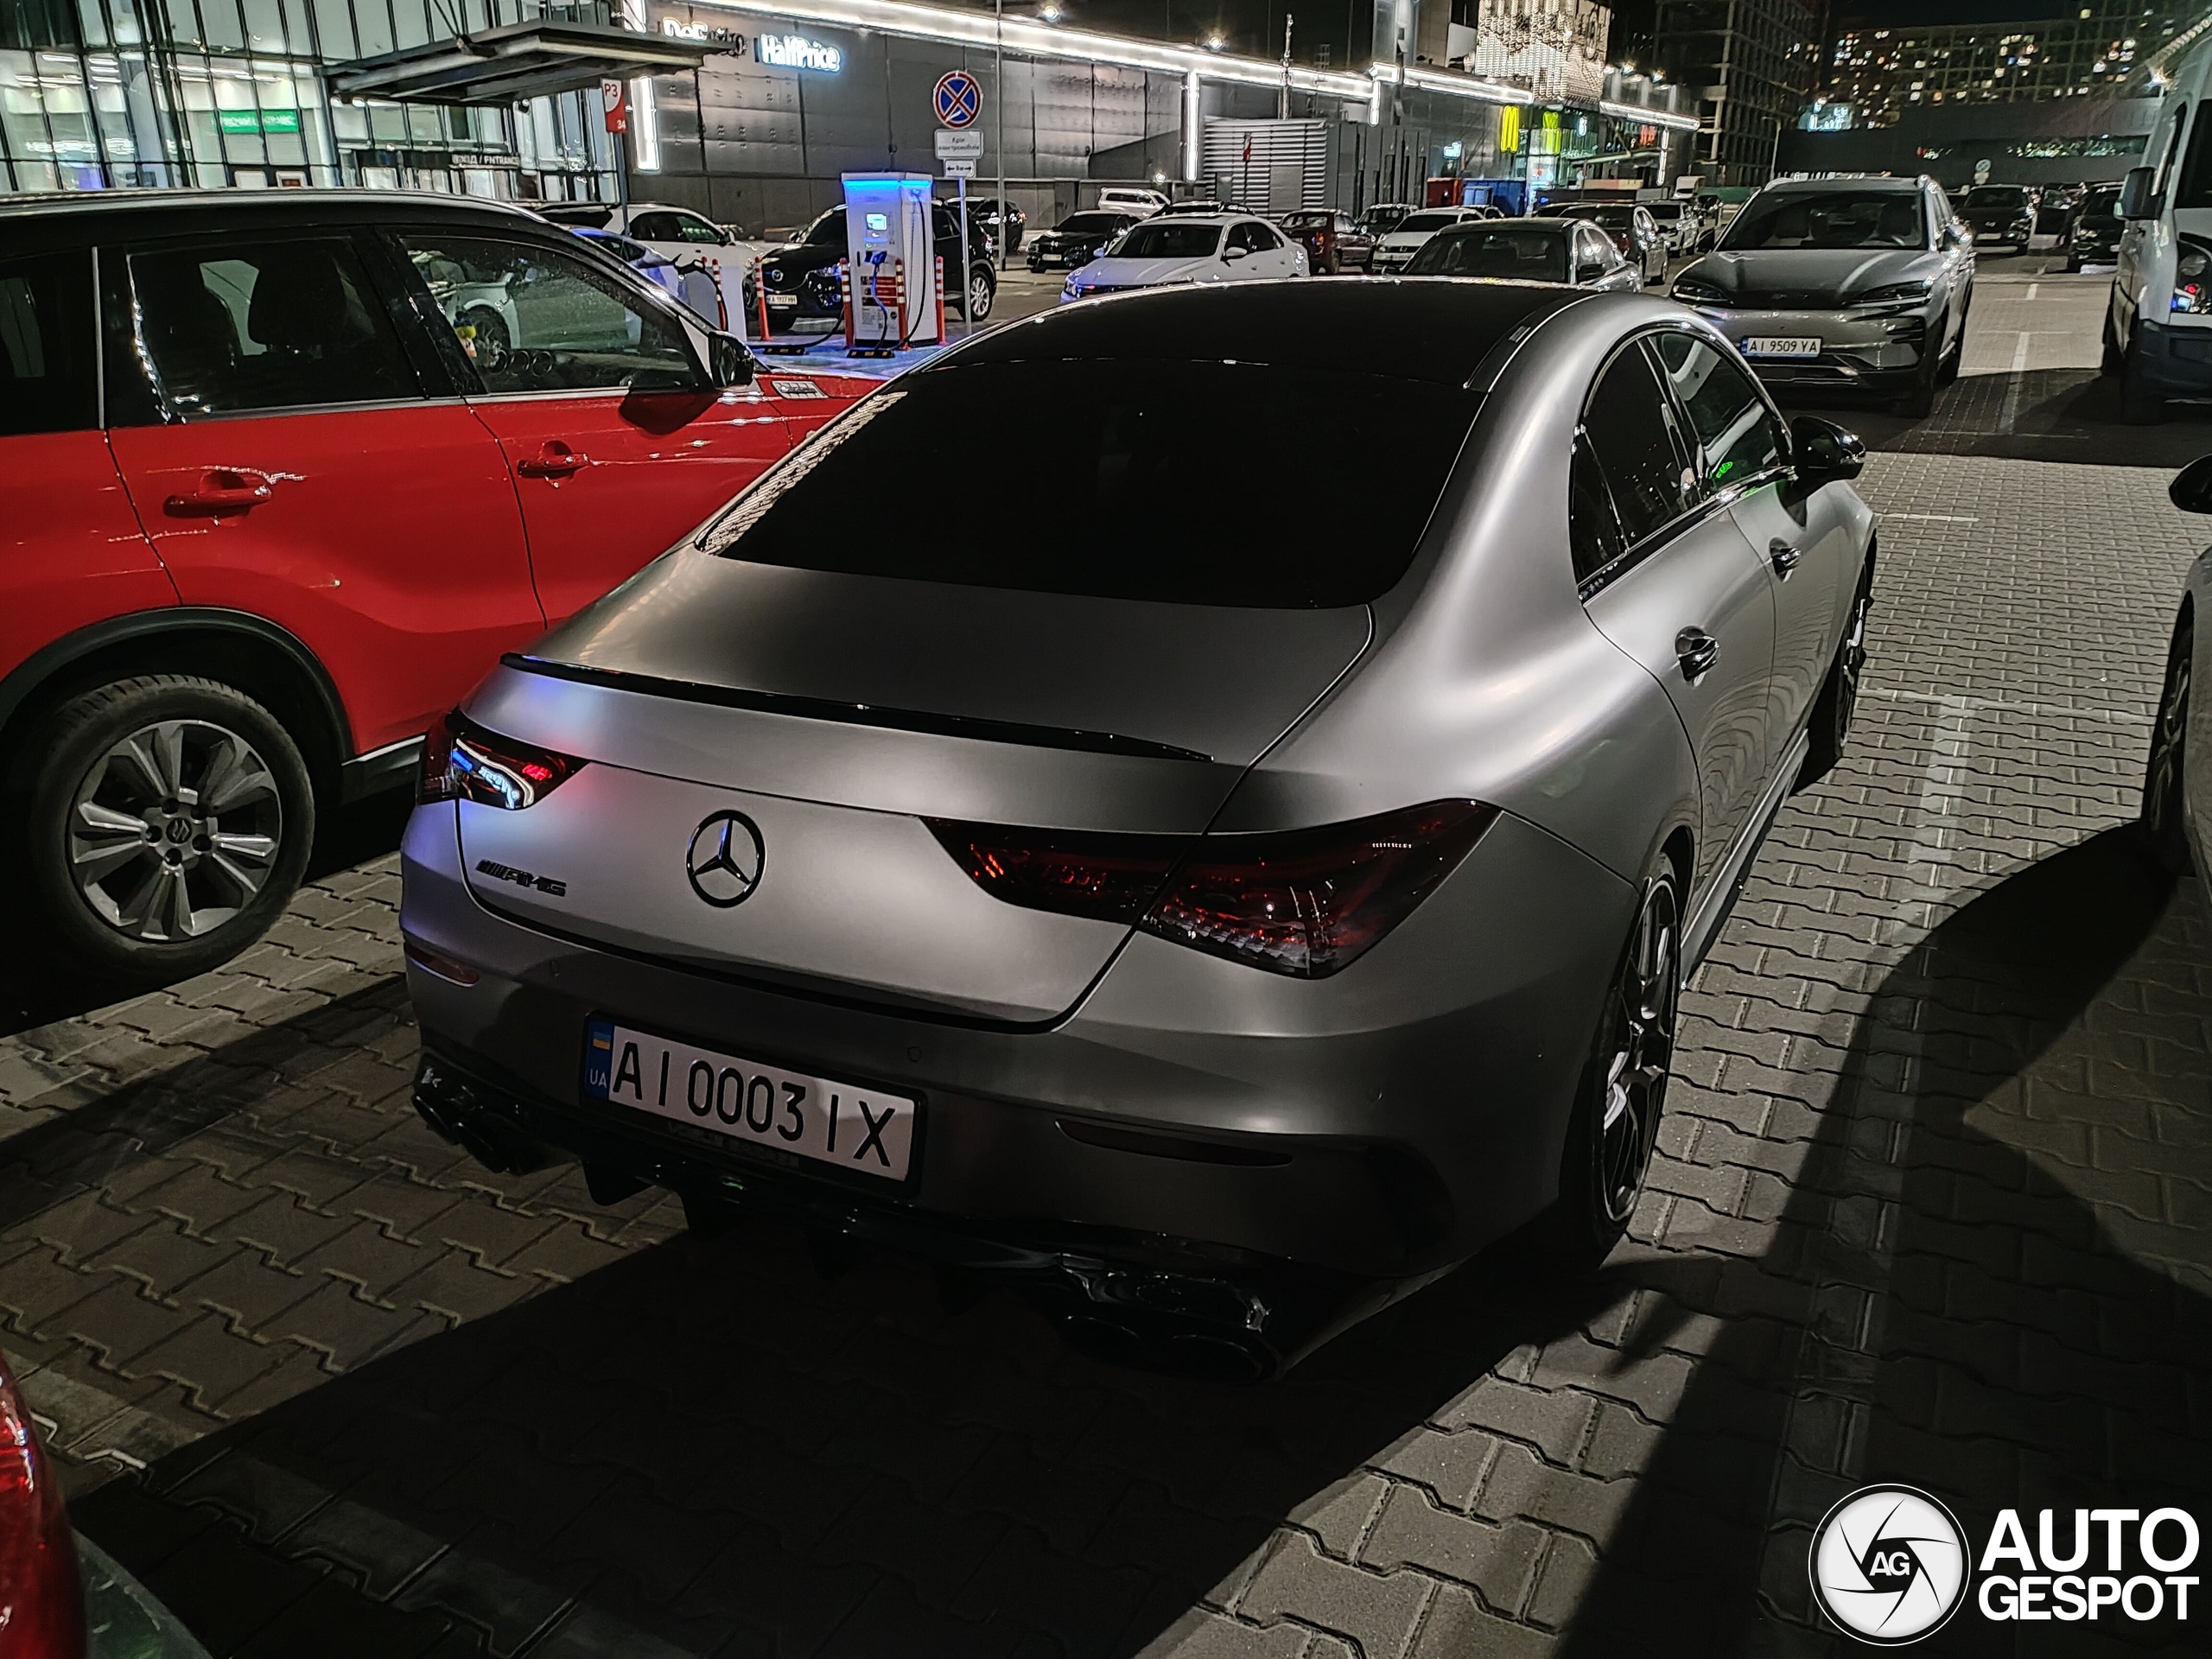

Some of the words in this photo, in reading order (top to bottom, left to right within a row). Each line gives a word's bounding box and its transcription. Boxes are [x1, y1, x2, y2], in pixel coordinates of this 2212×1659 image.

[761, 34, 839, 71] HalfPrice
[605, 83, 618, 98] P3
[1749, 340, 1764, 352] AI
[1770, 340, 1797, 352] 9509
[1802, 340, 1817, 353] YA
[589, 1067, 607, 1089] UA
[612, 1041, 671, 1107] AI
[688, 1059, 806, 1142] 0003
[826, 1094, 896, 1167] IX
